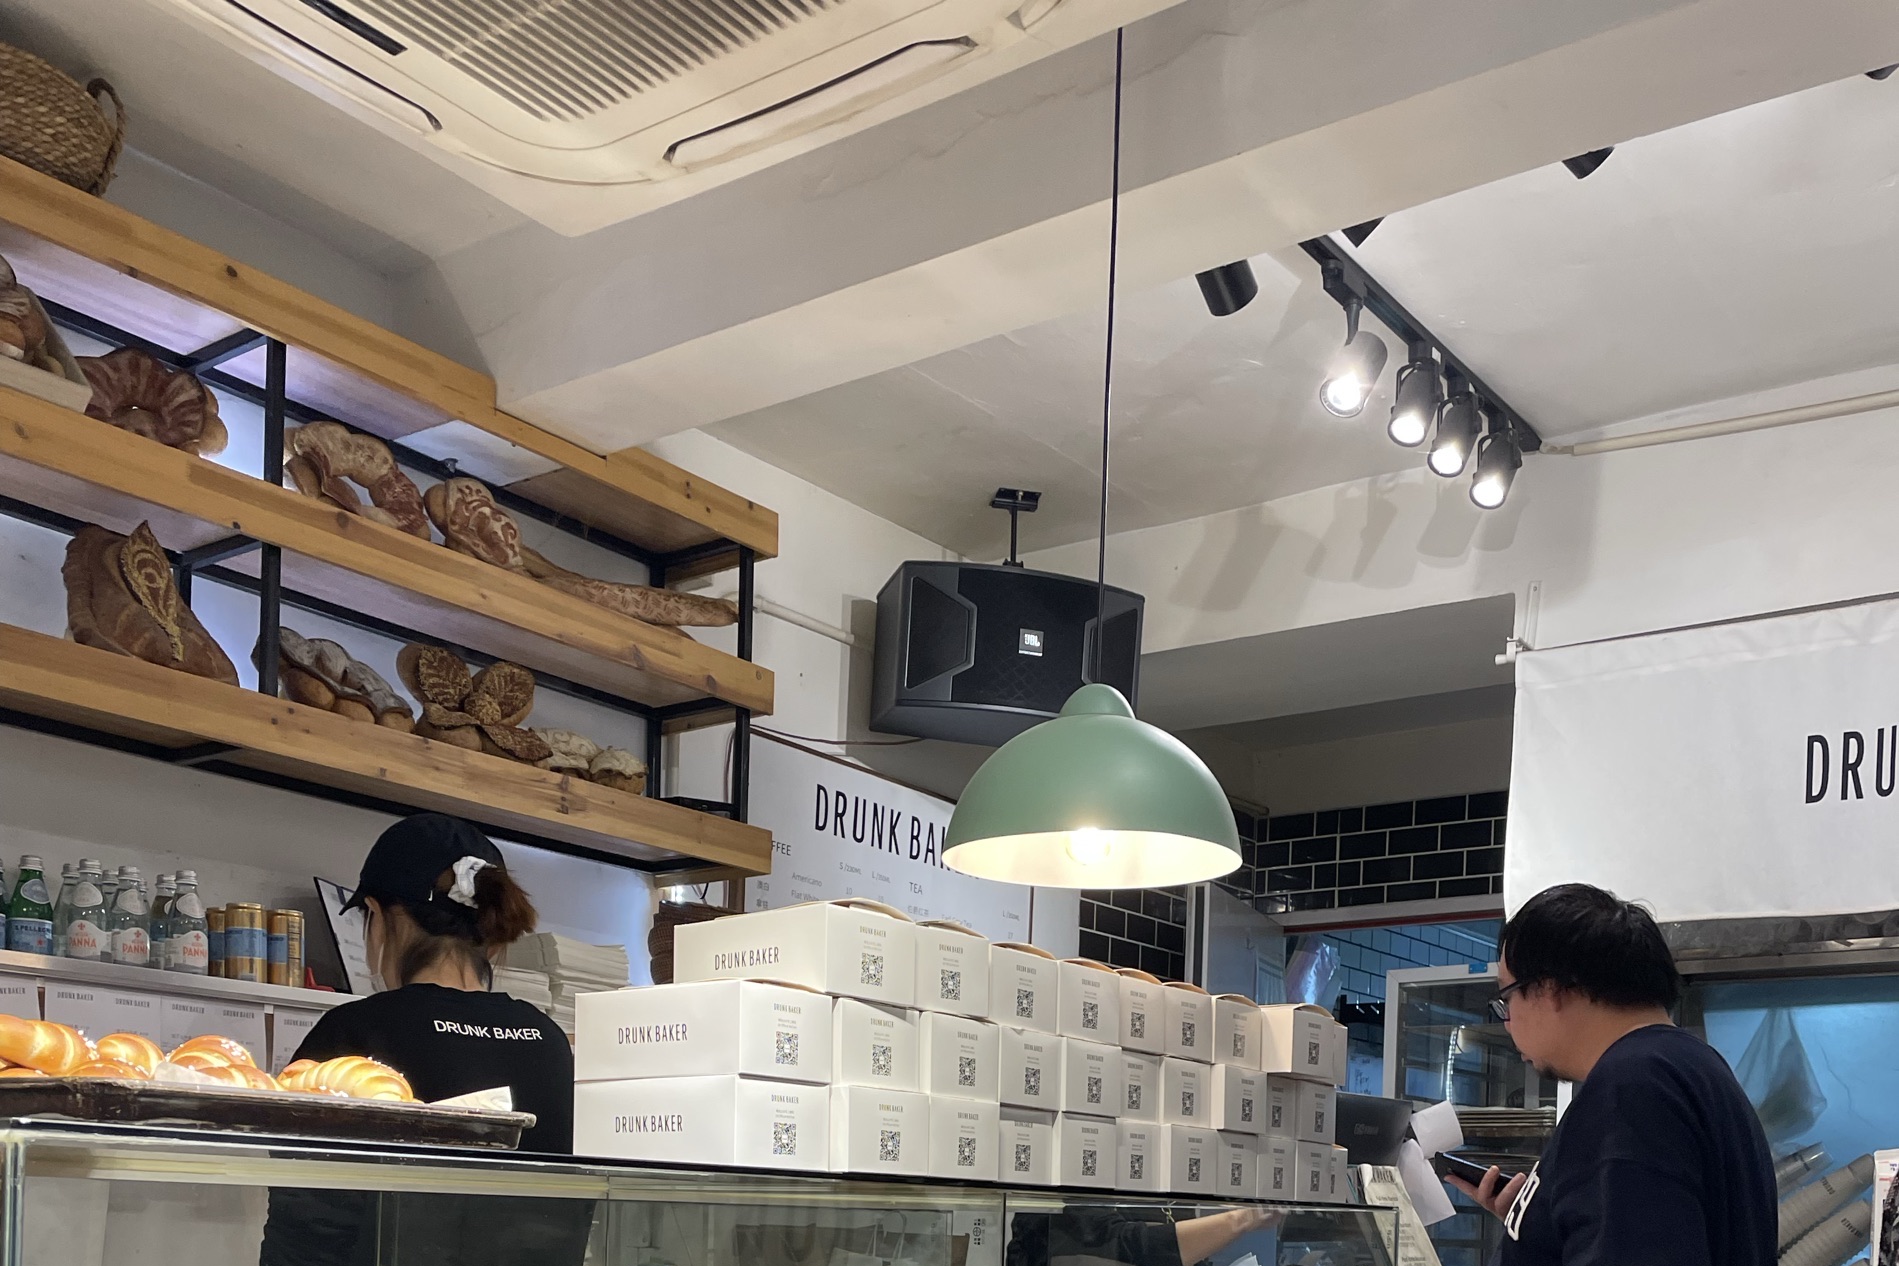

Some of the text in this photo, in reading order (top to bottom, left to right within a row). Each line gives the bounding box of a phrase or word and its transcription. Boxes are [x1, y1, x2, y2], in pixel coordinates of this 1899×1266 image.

[1024, 633, 1041, 647] JBL
[1804, 725, 1898, 804] DRU
[815, 784, 901, 856] DRUNK
[792, 872, 823, 887] Americano
[909, 881, 923, 895] TEA
[715, 946, 779, 970] DRUNK BAKER
[434, 1020, 543, 1040] DRUNK BAKER
[617, 1023, 688, 1044] DRUNK BAKER
[615, 1114, 683, 1133] DRUNK BAKER
